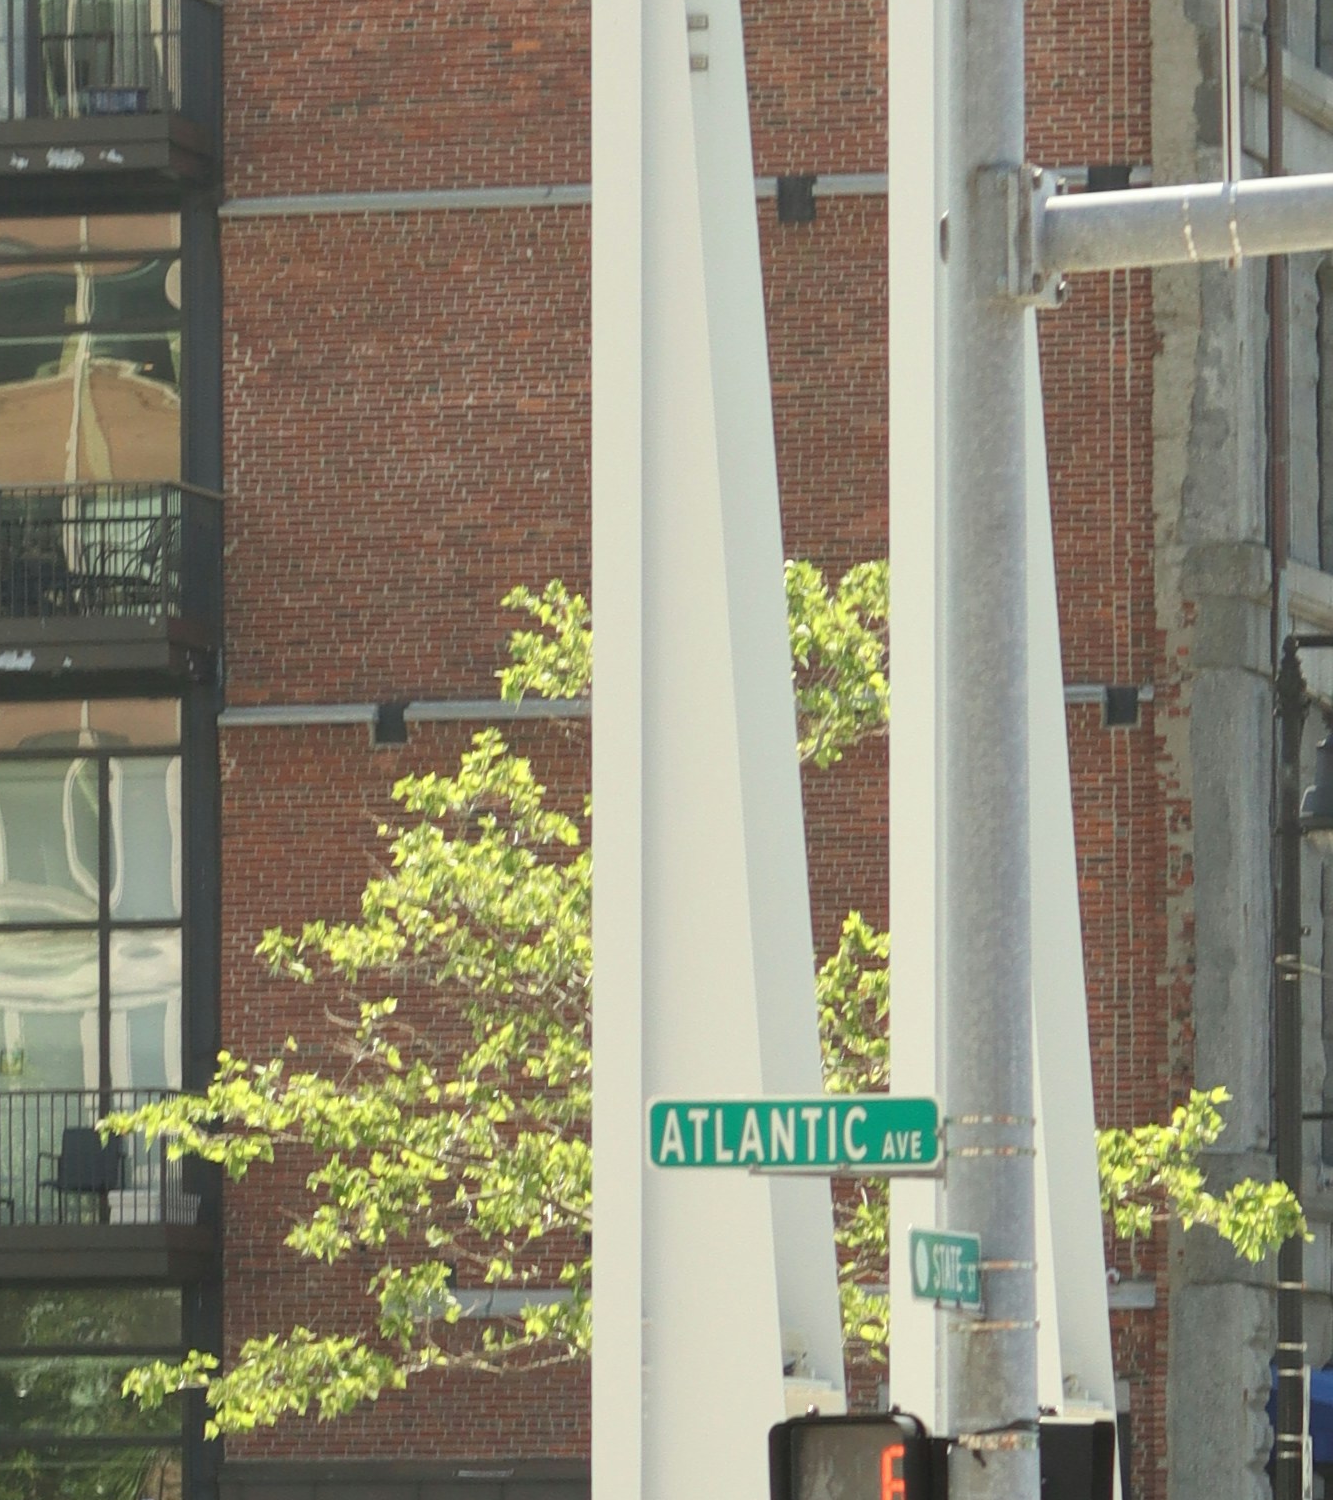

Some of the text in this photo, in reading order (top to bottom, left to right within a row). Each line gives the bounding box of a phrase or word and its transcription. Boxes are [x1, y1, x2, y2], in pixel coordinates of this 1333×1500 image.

[659, 1106, 922, 1163] ATLANTIC AVE
[933, 1243, 963, 1293] STATE
